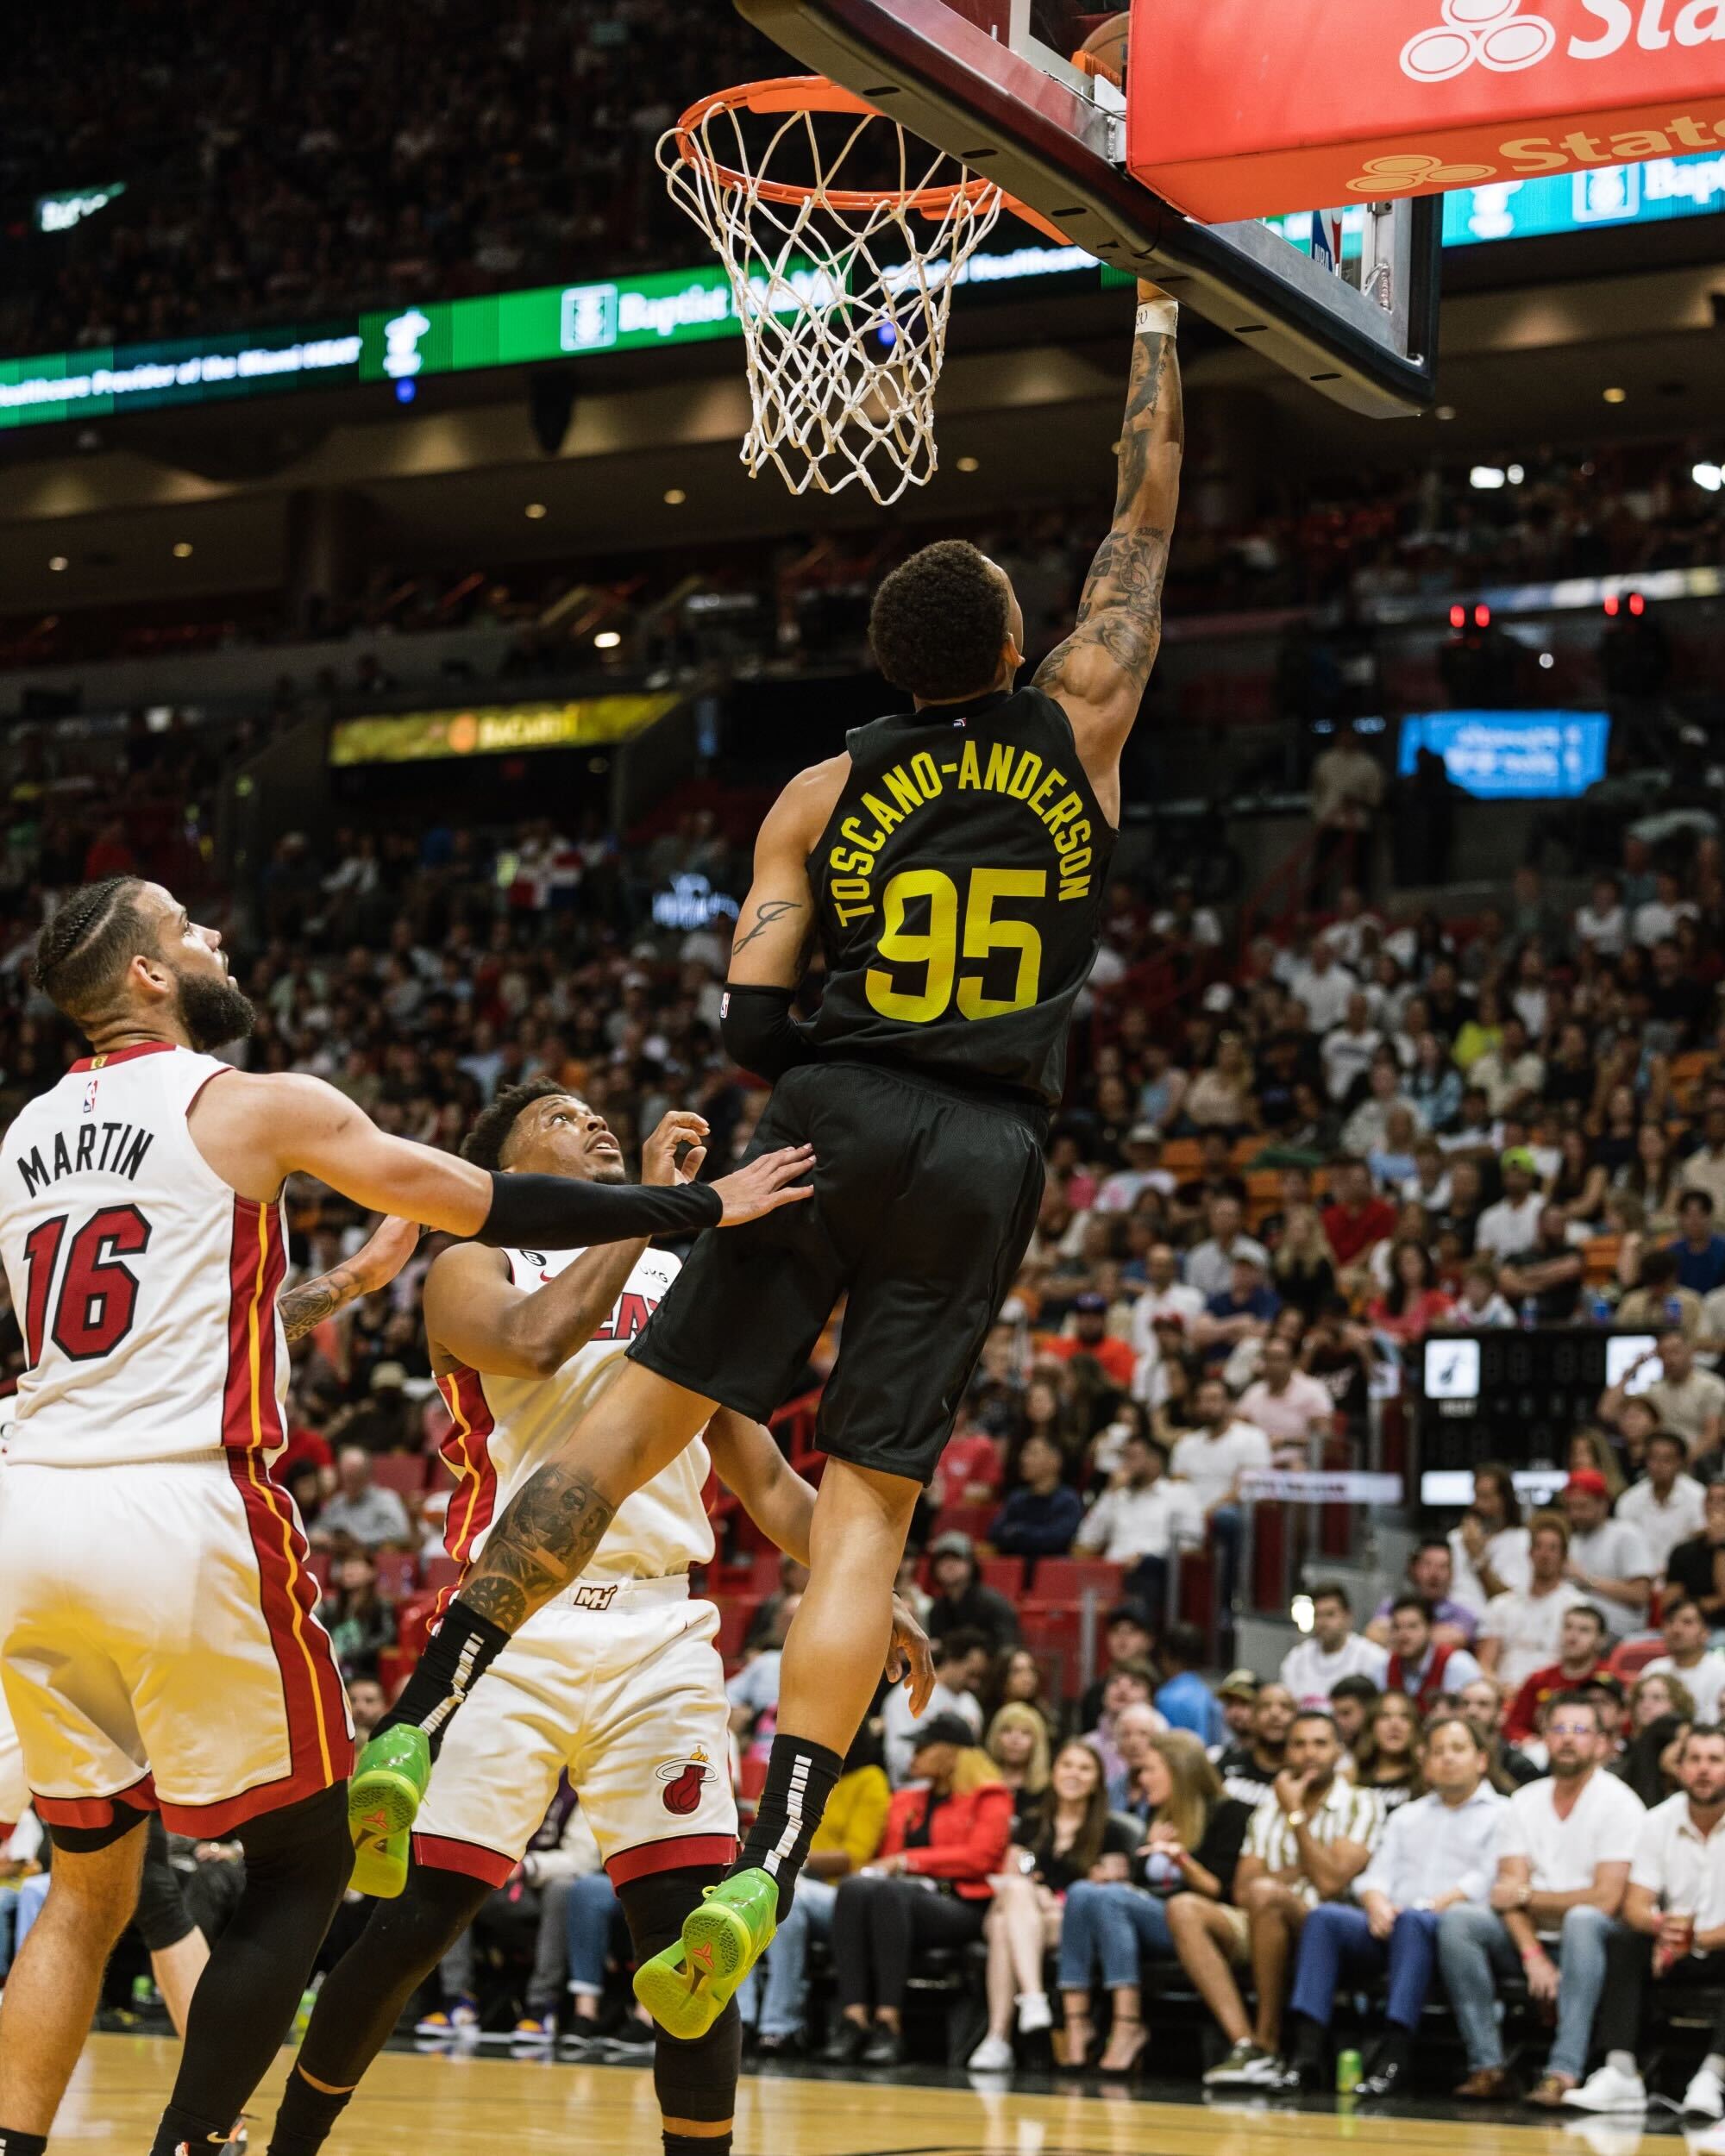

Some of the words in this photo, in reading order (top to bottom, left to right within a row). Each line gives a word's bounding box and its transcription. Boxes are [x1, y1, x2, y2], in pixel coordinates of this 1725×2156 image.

[1499, 116, 1725, 172] Stat
[619, 285, 729, 336] Baptist
[830, 740, 1092, 927] TOSCANO-ANDERSON
[865, 868, 1046, 1023] 95
[16, 1122, 154, 1199] MARTIN
[23, 1203, 153, 1371] 16
[574, 1585, 618, 1610] MH
